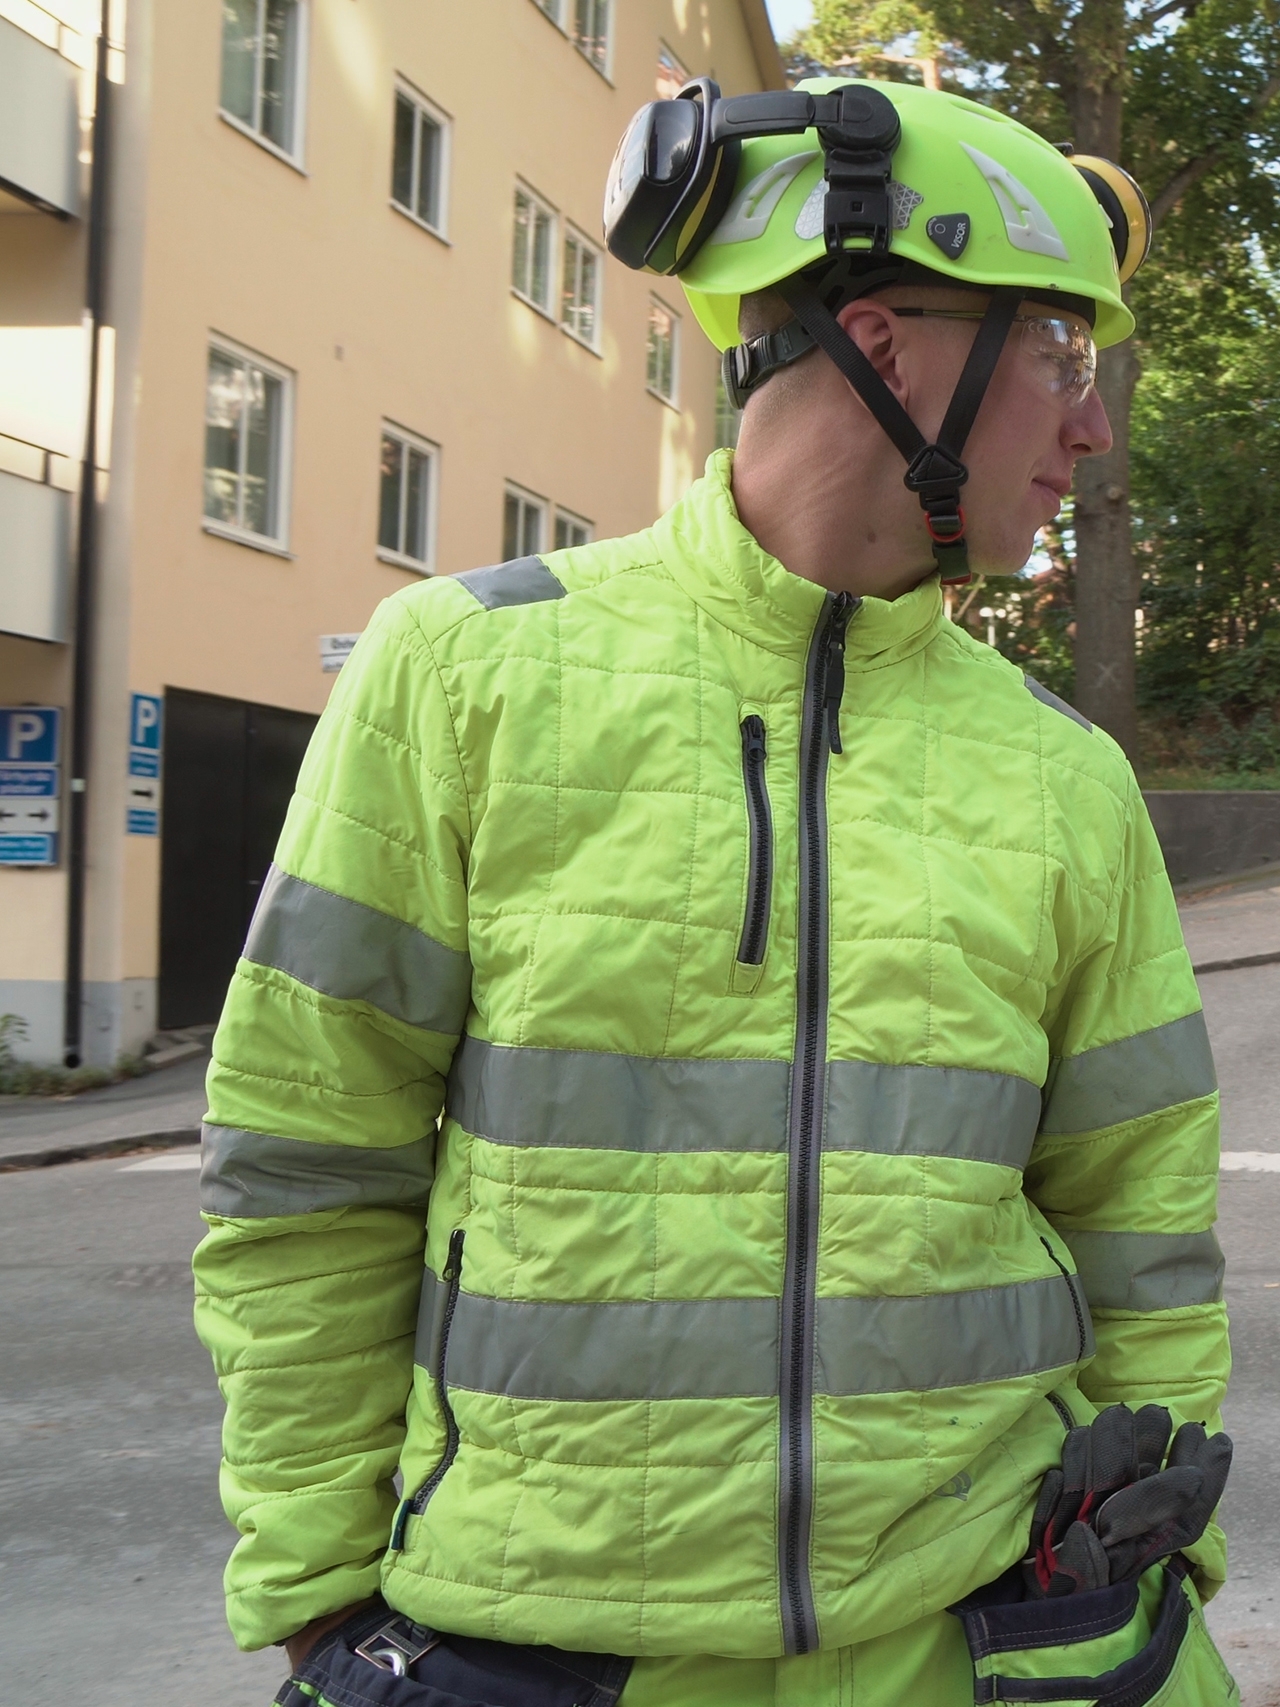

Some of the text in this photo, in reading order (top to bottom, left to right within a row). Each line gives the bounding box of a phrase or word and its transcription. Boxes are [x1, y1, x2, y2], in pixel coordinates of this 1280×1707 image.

[951, 222, 966, 248] VISOR
[8, 713, 46, 759] P
[136, 699, 157, 743] P
